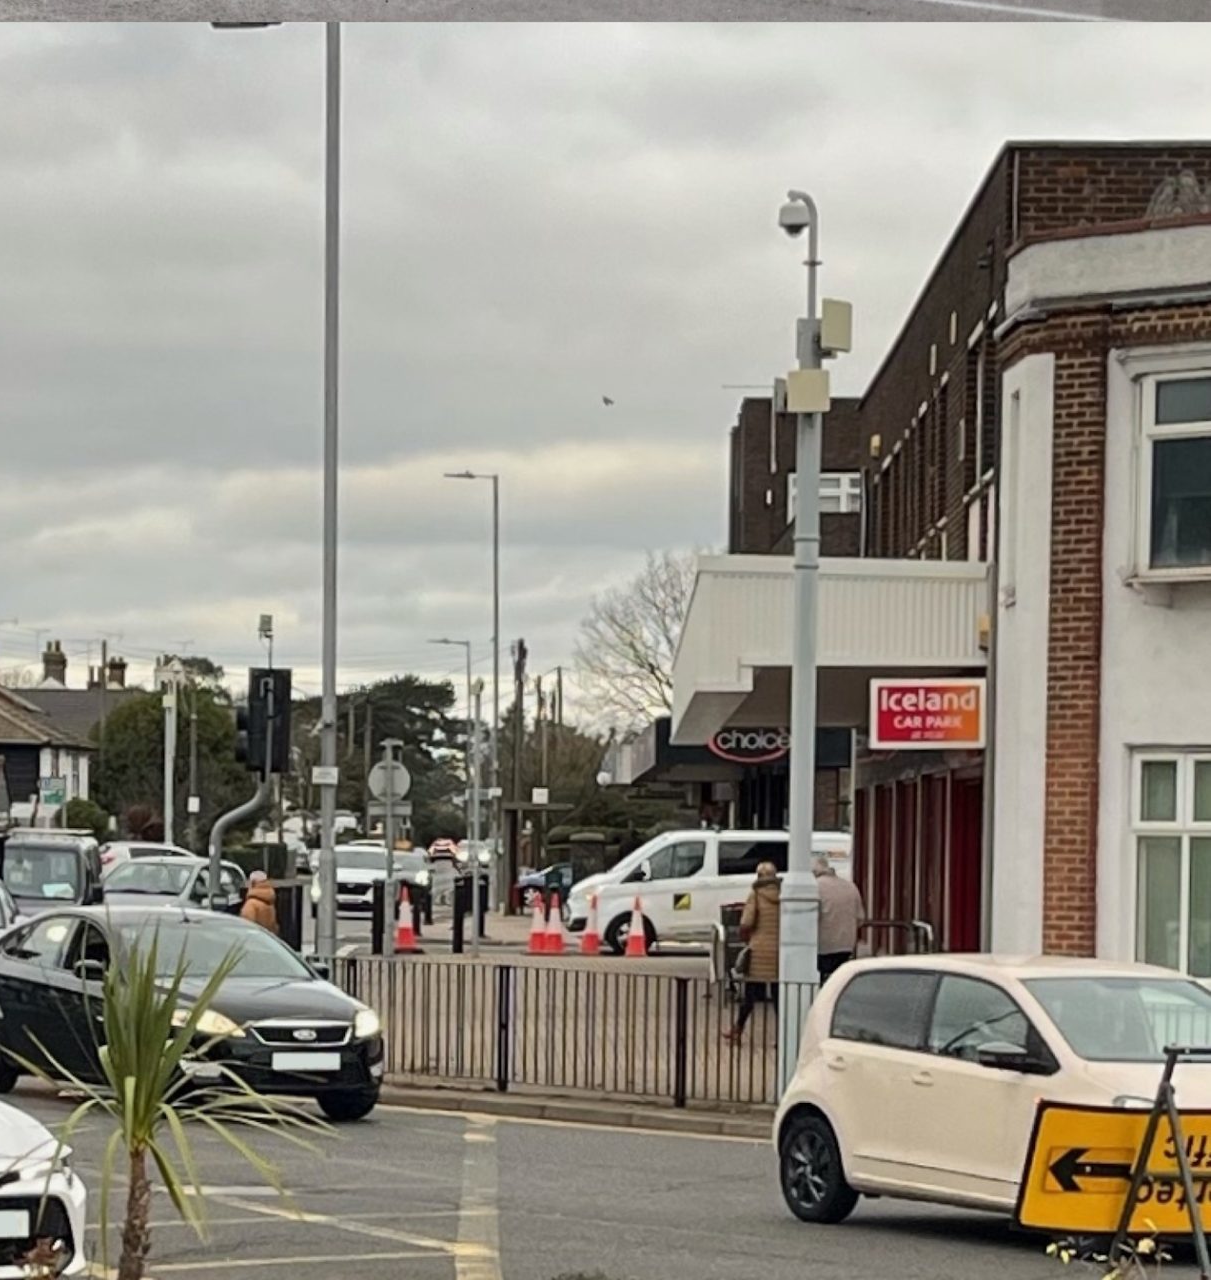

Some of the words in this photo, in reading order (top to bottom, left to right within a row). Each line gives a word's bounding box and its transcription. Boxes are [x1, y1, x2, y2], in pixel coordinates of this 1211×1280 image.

[881, 688, 977, 712] Iceland
[893, 715, 923, 729] CAR
[925, 715, 963, 729] PARK
